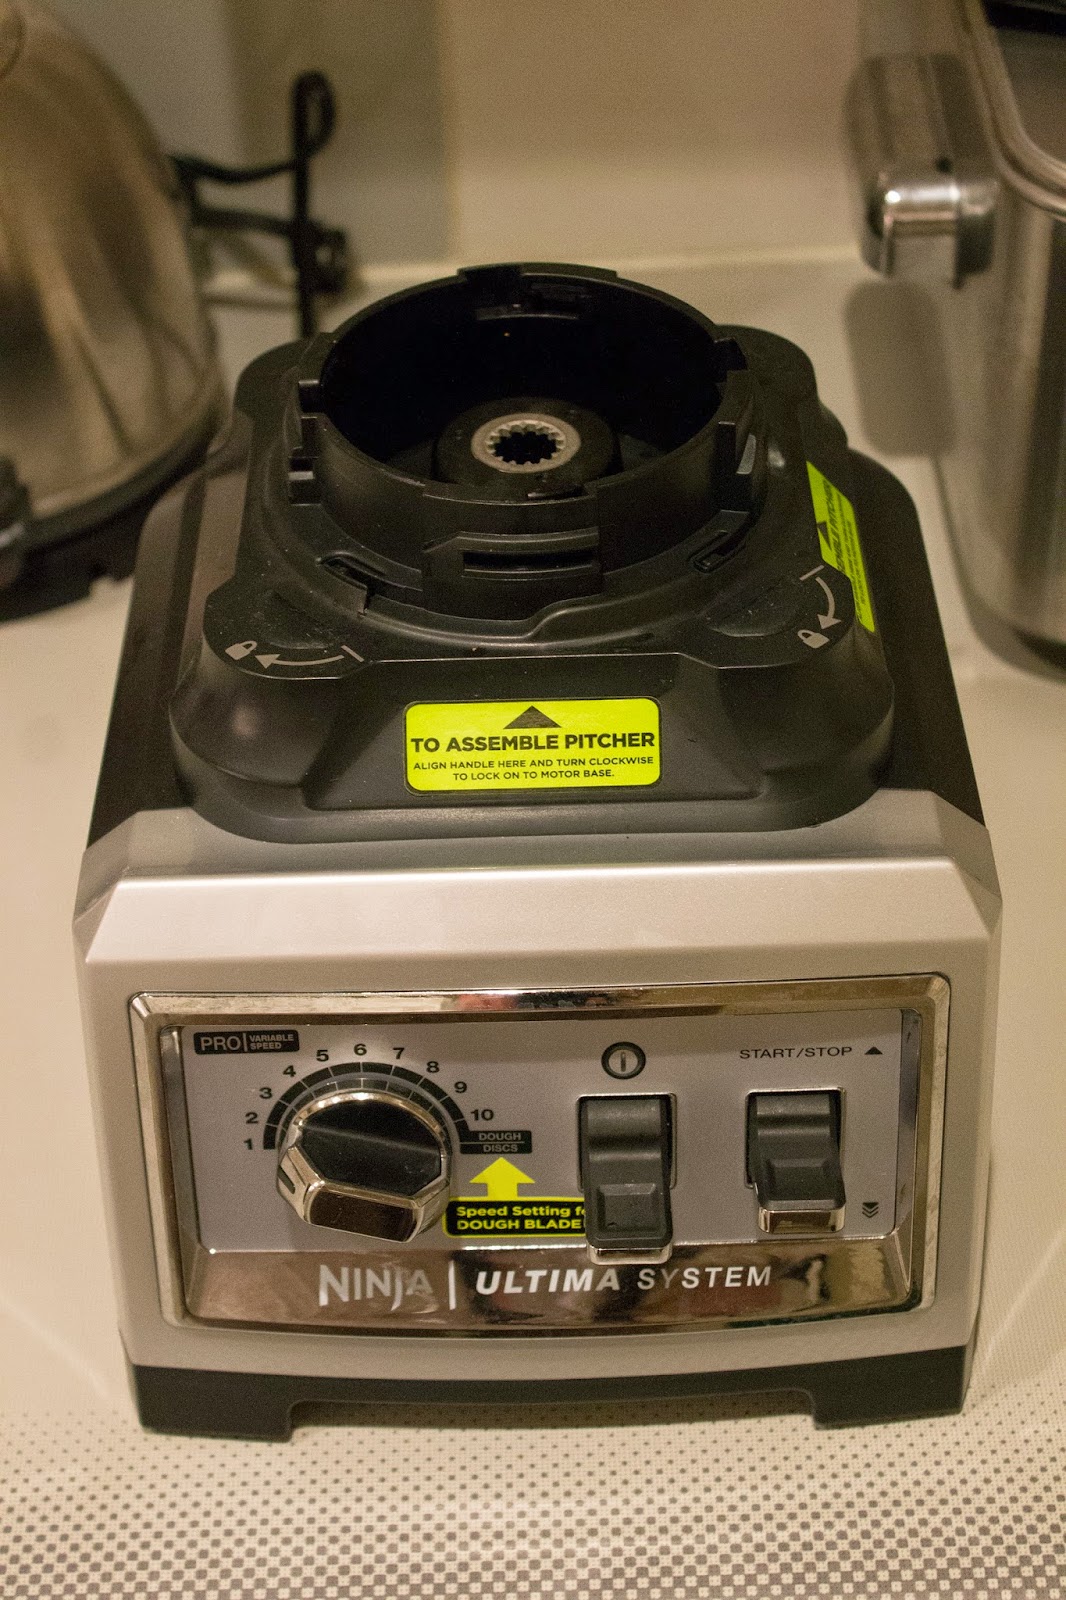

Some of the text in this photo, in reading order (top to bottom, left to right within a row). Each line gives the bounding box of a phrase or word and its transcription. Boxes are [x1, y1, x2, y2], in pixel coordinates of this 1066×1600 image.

[411, 732, 656, 752] TO ASSEMBLE PITCHER
[413, 756, 654, 770] ALIGN HANDLE HERE AND TURN CLOCKWISE
[453, 769, 615, 781] TO LOCK ON TO MOTOR BASE.
[200, 1035, 242, 1051] PRO
[249, 1034, 294, 1042] VARIABLE
[249, 1041, 282, 1050] SPEED
[354, 1044, 368, 1056] 6
[316, 1050, 330, 1062] 5
[392, 1047, 405, 1059] 7
[739, 1046, 853, 1059] START/STOP
[282, 1065, 297, 1077] 4
[426, 1061, 440, 1073] 8
[259, 1087, 273, 1099] 3
[454, 1081, 468, 1093] 9
[245, 1112, 259, 1124] 2
[470, 1109, 494, 1121] 10
[478, 1131, 522, 1142] DOUGH
[244, 1139, 254, 1150] 1
[482, 1144, 519, 1153] DISCS
[456, 1206, 508, 1218] Speed
[512, 1206, 571, 1217] Setting
[456, 1219, 585, 1230] DOUGH BLADE
[475, 1265, 772, 1295] ULTIMA SYSTEM
[319, 1264, 434, 1311] NINJA
